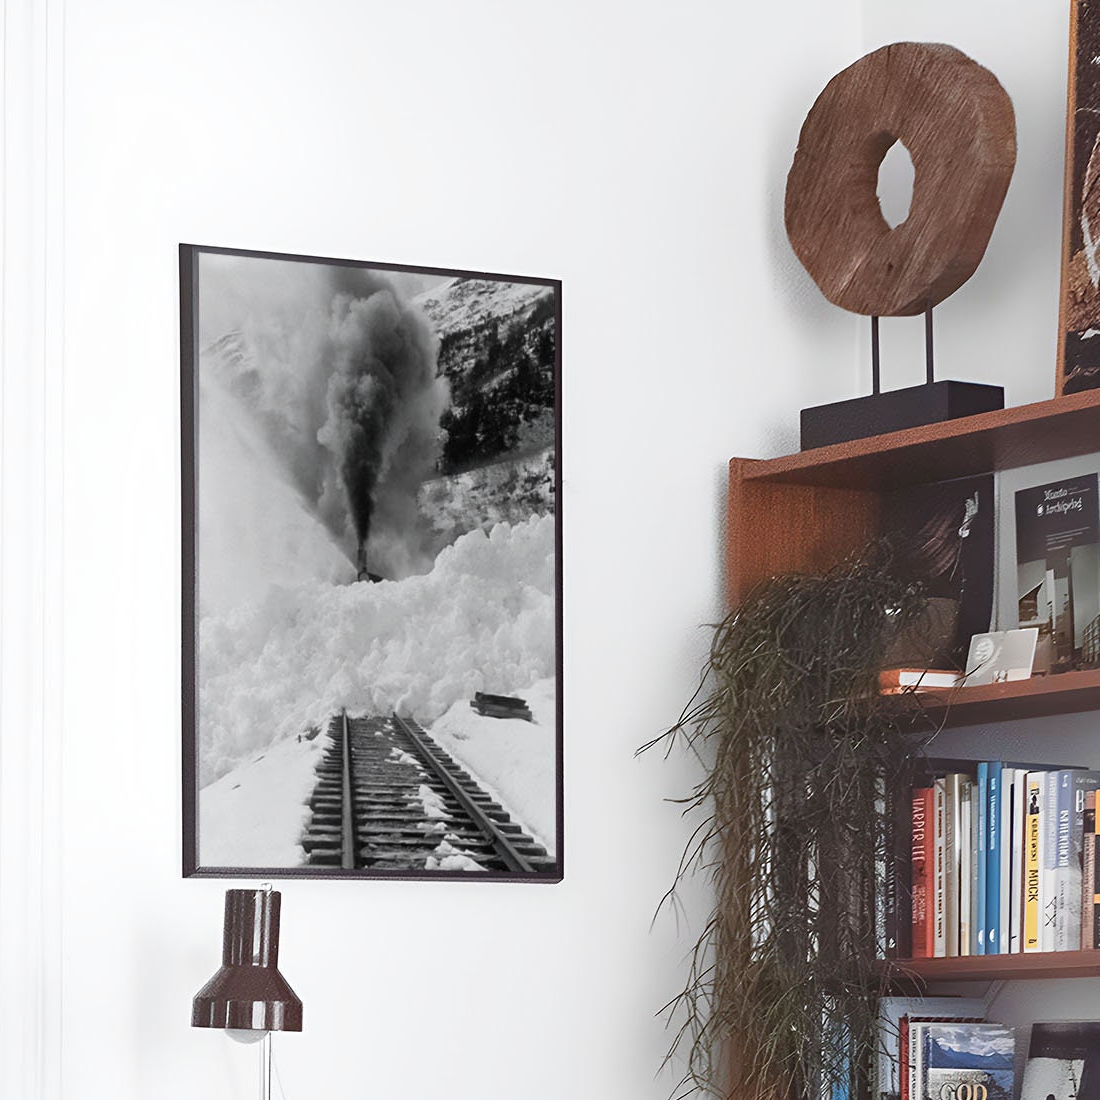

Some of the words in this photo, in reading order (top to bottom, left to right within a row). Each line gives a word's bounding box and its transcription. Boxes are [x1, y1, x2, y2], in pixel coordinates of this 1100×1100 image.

[911, 797, 925, 842] HARPER
[911, 844, 925, 862] LEE
[1027, 868, 1039, 902] MOCK
